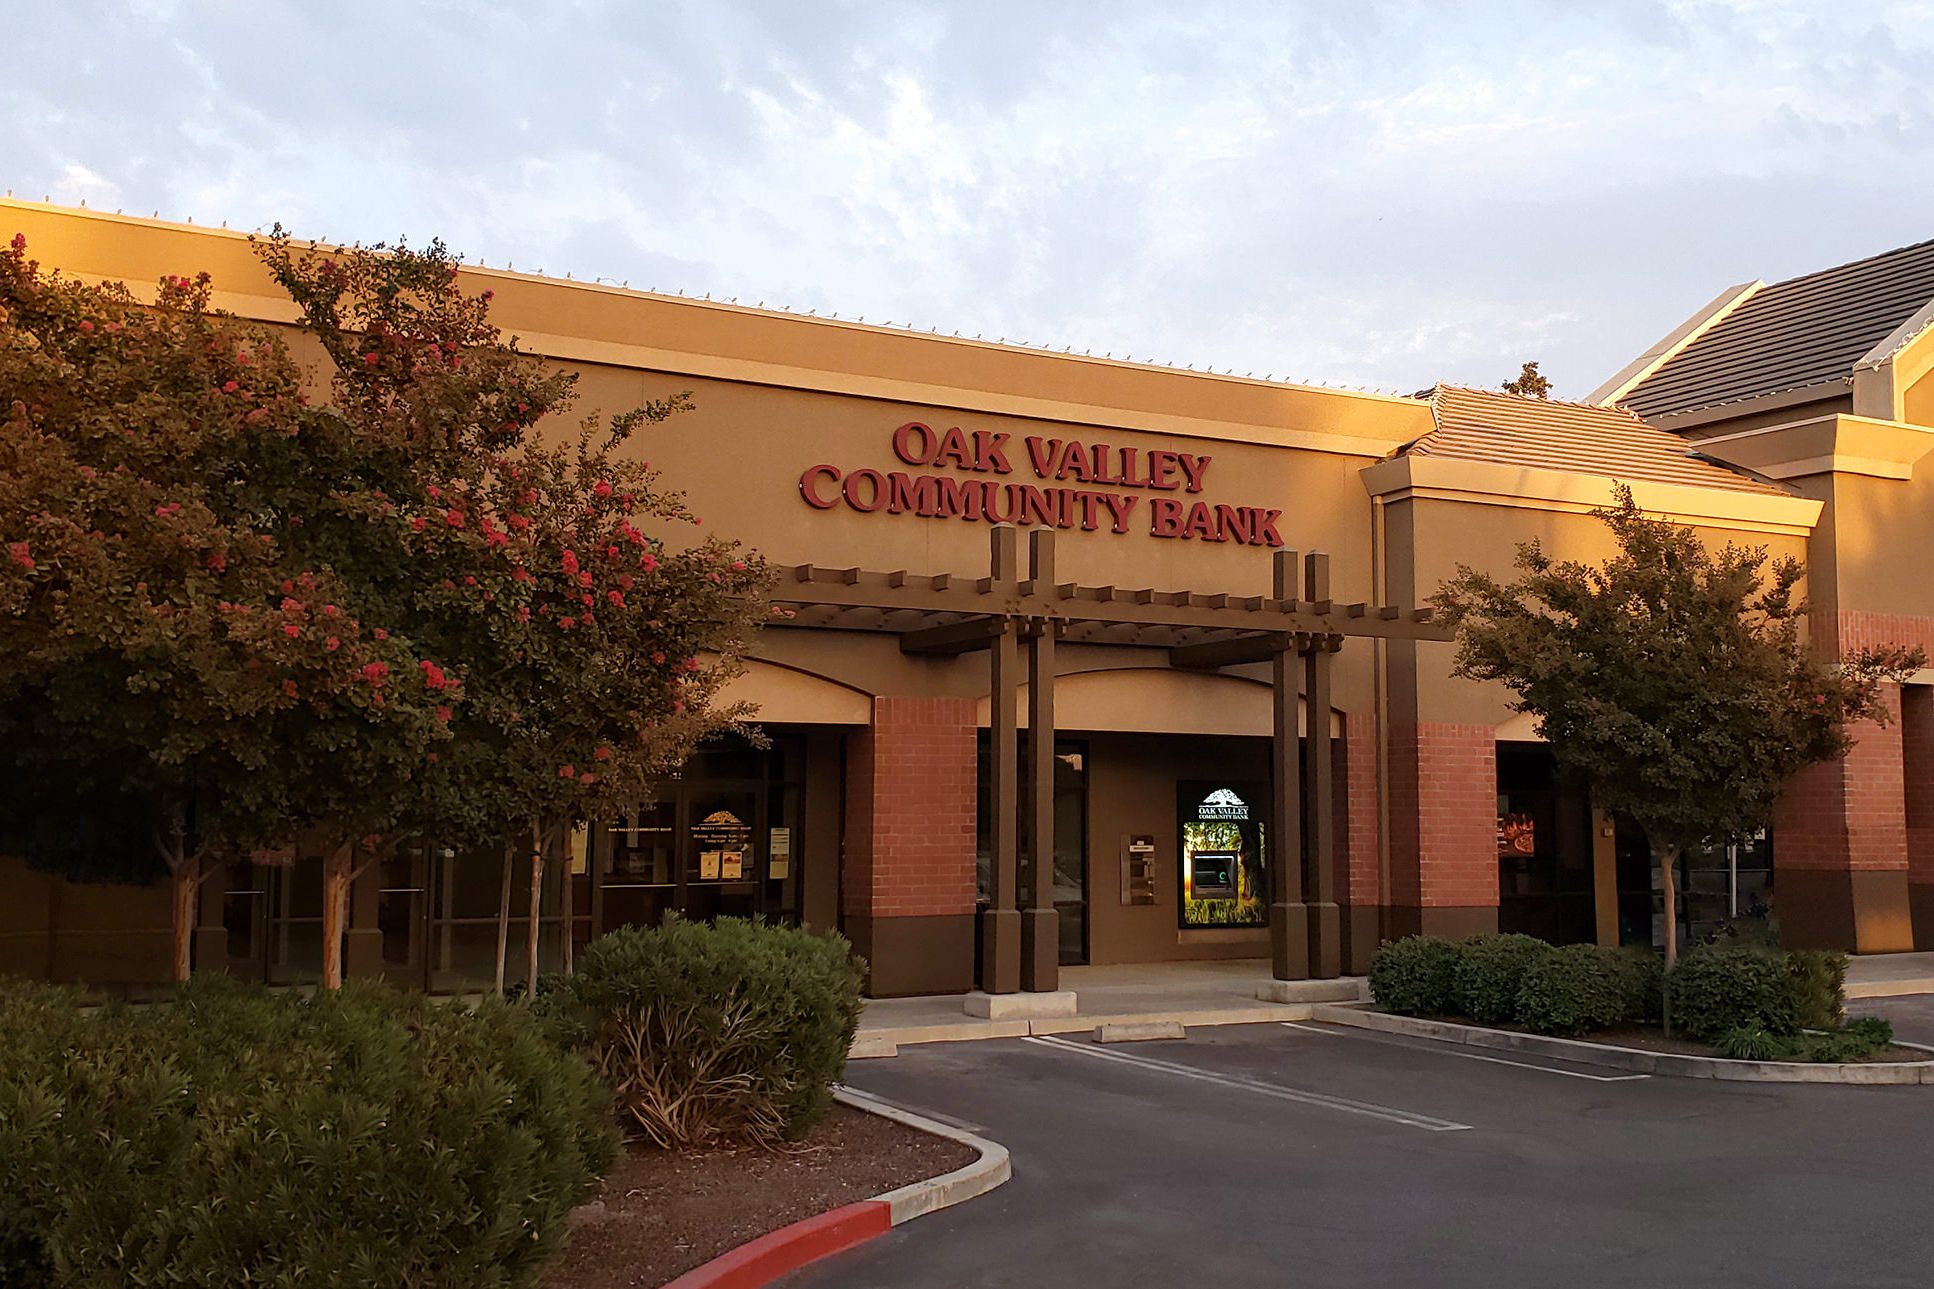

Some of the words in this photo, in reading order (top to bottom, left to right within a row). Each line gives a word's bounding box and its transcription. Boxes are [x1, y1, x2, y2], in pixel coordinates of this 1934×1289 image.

[892, 422, 1013, 474] OAK
[1024, 435, 1212, 493] VALLEY
[799, 464, 1139, 534] COMMUNITY
[1149, 498, 1285, 547] BANK
